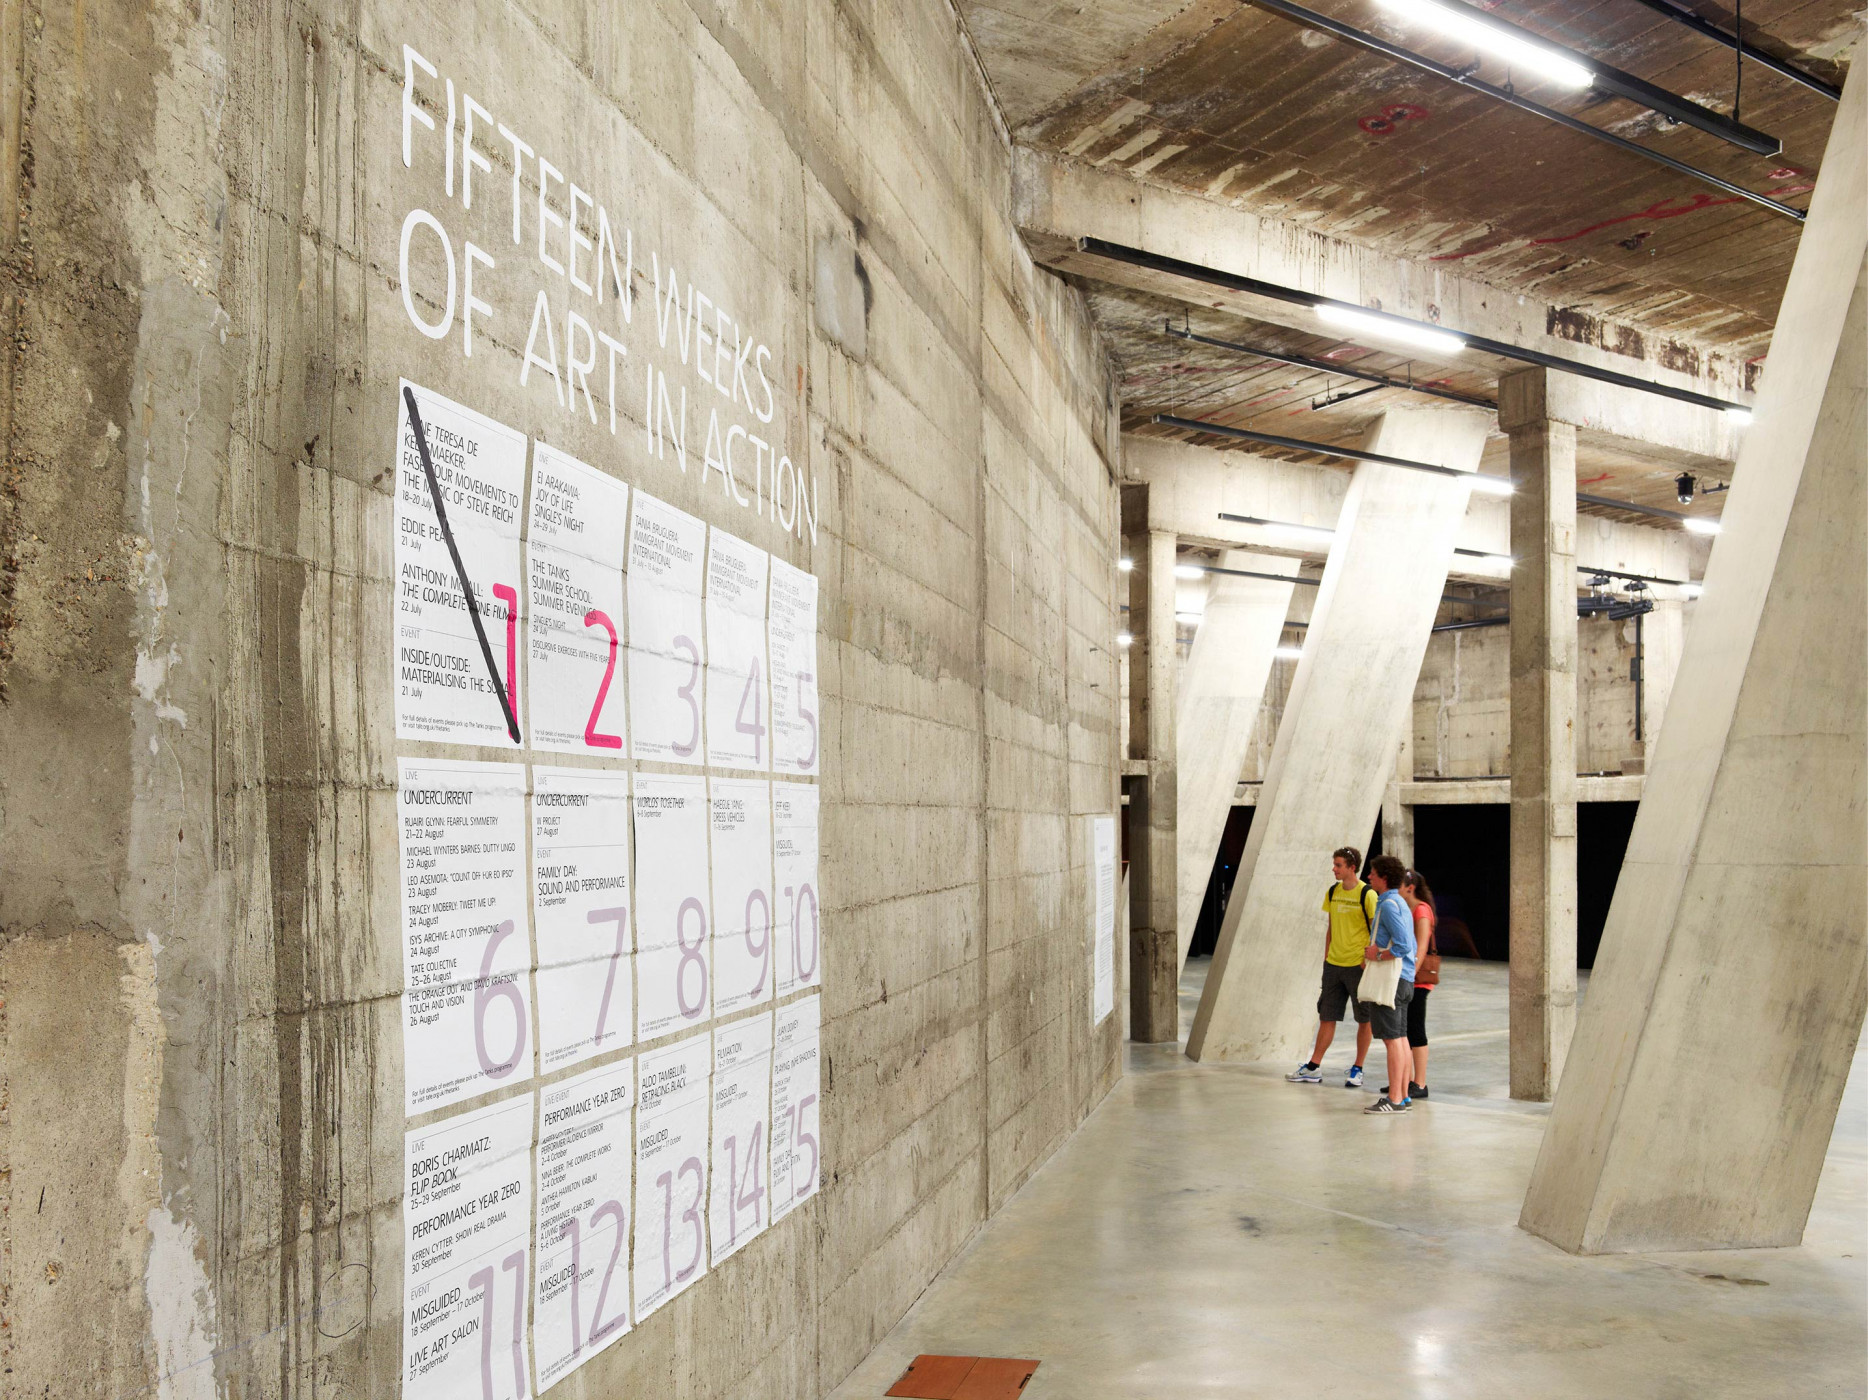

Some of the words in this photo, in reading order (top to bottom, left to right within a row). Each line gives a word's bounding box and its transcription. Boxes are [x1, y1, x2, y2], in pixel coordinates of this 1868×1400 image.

[402, 44, 632, 324] FIFTEEN
[652, 251, 773, 423] WEEKS
[399, 209, 495, 357] OF
[520, 290, 627, 435] ART
[648, 363, 686, 473] IN
[702, 408, 817, 547] ACTION
[405, 412, 431, 437] ANE
[435, 425, 464, 451] TERESA
[467, 439, 477, 457] DE
[455, 471, 506, 504] MOVEMENTS
[509, 492, 518, 508] TO
[538, 471, 543, 484] EI
[402, 470, 419, 492] THE
[423, 478, 450, 502] MSIC
[453, 489, 463, 507] OF
[467, 494, 489, 516] STEVE
[492, 503, 512, 525] REICH
[421, 496, 431, 512] July
[536, 488, 548, 502] JOY
[551, 494, 559, 508] OF
[562, 498, 573, 514] LIFE
[401, 516, 425, 538] EDDIE
[564, 516, 584, 534] NIGHT
[636, 515, 650, 530] TANIA
[411, 537, 421, 551] July
[634, 530, 664, 551] IMMIGRANT
[666, 543, 693, 563] MOVEMENT
[633, 544, 671, 569] INTERNATIONAL
[402, 561, 447, 588] ANTHONY
[532, 558, 545, 575] THE
[548, 563, 569, 582] TANKS
[532, 575, 563, 595] SUMMER
[401, 600, 407, 613] 22
[410, 602, 421, 616] July
[402, 581, 418, 599] THE
[423, 586, 465, 611] COMPLETE
[470, 598, 490, 616] ONE
[534, 592, 564, 611] SUMMER
[566, 601, 596, 620] EVENINGS
[401, 626, 419, 640] EVENT
[401, 646, 470, 674] INSIDE/OUTSIDE:
[492, 583, 518, 740] 1
[401, 666, 466, 690] MATERIALISING
[469, 677, 483, 692] THE
[487, 679, 512, 696] SOAL
[584, 610, 622, 749] 2
[401, 685, 408, 697] 21
[411, 687, 422, 699] July
[672, 635, 699, 757] 3
[735, 656, 765, 765] 4
[797, 670, 818, 771] 5
[405, 771, 417, 780] LIVE
[404, 789, 473, 805] UNDERCURRENT
[536, 793, 588, 806] UNDERCURRENT
[637, 796, 658, 808] WORLDS
[660, 797, 684, 808] TOGETHER
[446, 817, 468, 826] FEARFUL
[470, 817, 498, 826] SYMMETRY
[542, 816, 560, 825] PROJECT
[543, 827, 558, 837] August
[424, 829, 444, 839] August
[406, 846, 431, 856] MICHAEL
[433, 845, 458, 855] WYNTERS
[482, 843, 499, 853] DUTTY
[537, 849, 550, 858] EVENT
[406, 859, 414, 869] 23
[416, 858, 436, 868] August
[537, 865, 561, 879] FAMILY
[407, 875, 417, 885] LEO
[408, 888, 415, 898] 23
[417, 886, 436, 897] August
[538, 881, 562, 896] SOUND
[564, 880, 579, 893] AND
[581, 876, 624, 891] PERFORMANCE
[409, 904, 430, 916] TRACEY
[459, 899, 475, 910] TWEET
[543, 896, 566, 906] September
[409, 917, 416, 928] 24
[418, 915, 438, 927] August
[468, 924, 499, 938] SYMPHONIC
[745, 889, 770, 999] 9
[784, 883, 818, 988] 10
[410, 947, 417, 957] 24
[419, 944, 439, 956] August
[676, 897, 708, 1020] 8
[411, 963, 424, 975] TATE
[432, 970, 451, 984] August
[587, 906, 627, 1046] 7
[421, 986, 445, 1000] ORANGE
[460, 981, 472, 993] AND
[474, 920, 527, 1080] 6
[409, 1001, 429, 1015] TOUCH
[431, 998, 444, 1010] AND
[446, 994, 464, 1007] VISION
[410, 1015, 417, 1027] 26
[419, 1011, 439, 1025] August
[641, 1073, 656, 1089] ALDO
[641, 1082, 669, 1104] RETRACING
[671, 1076, 686, 1092] BLACK
[544, 1097, 590, 1127] PERFORMANCE
[592, 1090, 608, 1108] YEAR
[610, 1084, 625, 1101] ZERO
[412, 1140, 424, 1154] LIVE
[640, 1127, 668, 1151] MISGUIDED
[787, 1093, 817, 1204] 15
[412, 1154, 439, 1178] BORIS
[442, 1135, 491, 1167] CHARMATZ:
[551, 1146, 567, 1161] October
[574, 1149, 596, 1167] COMPLETE
[597, 1142, 610, 1156] WORKS
[411, 1176, 429, 1197] FLIP
[431, 1165, 457, 1189] BOOK
[431, 1180, 460, 1202] September
[550, 1171, 566, 1187] October
[581, 1172, 597, 1187] KABUKI
[723, 1121, 765, 1247] 14
[412, 1199, 475, 1241] PERFORMANCE
[480, 1189, 498, 1211] YEAR
[501, 1180, 520, 1201] ZERO
[540, 1208, 569, 1232] PERFORMANCE
[411, 1245, 429, 1263] KEREN
[455, 1226, 472, 1242] SHOW
[474, 1219, 485, 1234] REAL
[487, 1210, 506, 1227] DRAMA
[657, 1157, 704, 1293] 13
[411, 1262, 419, 1275] 30
[421, 1246, 452, 1270] September
[539, 1262, 575, 1295] MISGUIDED
[559, 1200, 626, 1359] 12
[410, 1282, 429, 1301] EVENT
[545, 1280, 568, 1303] September
[411, 1286, 460, 1326] MISGUIDED
[420, 1308, 450, 1334] September
[464, 1289, 484, 1309] October
[468, 1249, 525, 1400] 11
[410, 1345, 427, 1370] LIVE
[430, 1333, 447, 1357] ART
[451, 1315, 479, 1345] SALON
[409, 1367, 416, 1382] 27
[418, 1348, 449, 1376] September
